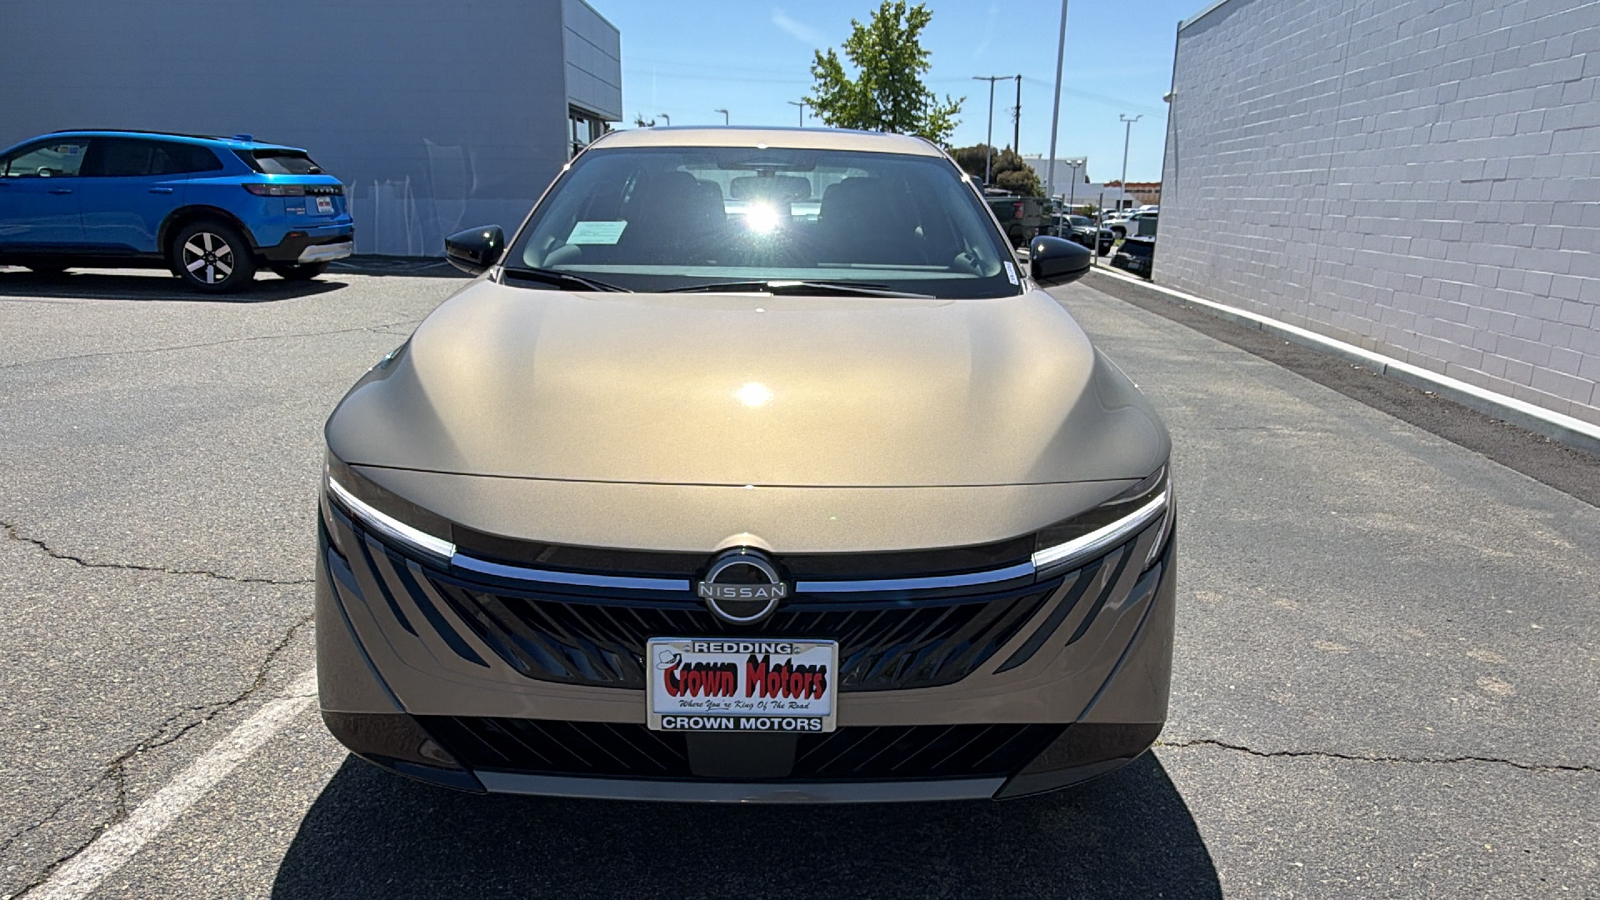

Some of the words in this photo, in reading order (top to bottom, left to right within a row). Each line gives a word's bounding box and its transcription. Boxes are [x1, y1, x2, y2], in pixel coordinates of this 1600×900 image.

[700, 585, 785, 598] NISSAN
[694, 642, 792, 654] REDDING
[664, 655, 738, 698] Crown
[745, 655, 828, 700] Motors
[679, 700, 703, 708] Where
[705, 700, 732, 711] You're
[734, 700, 754, 710] King
[757, 701, 768, 711] Of
[770, 701, 785, 709] The
[788, 701, 810, 710] Road
[662, 716, 734, 729] CROWN
[740, 717, 822, 730] MOTORS
